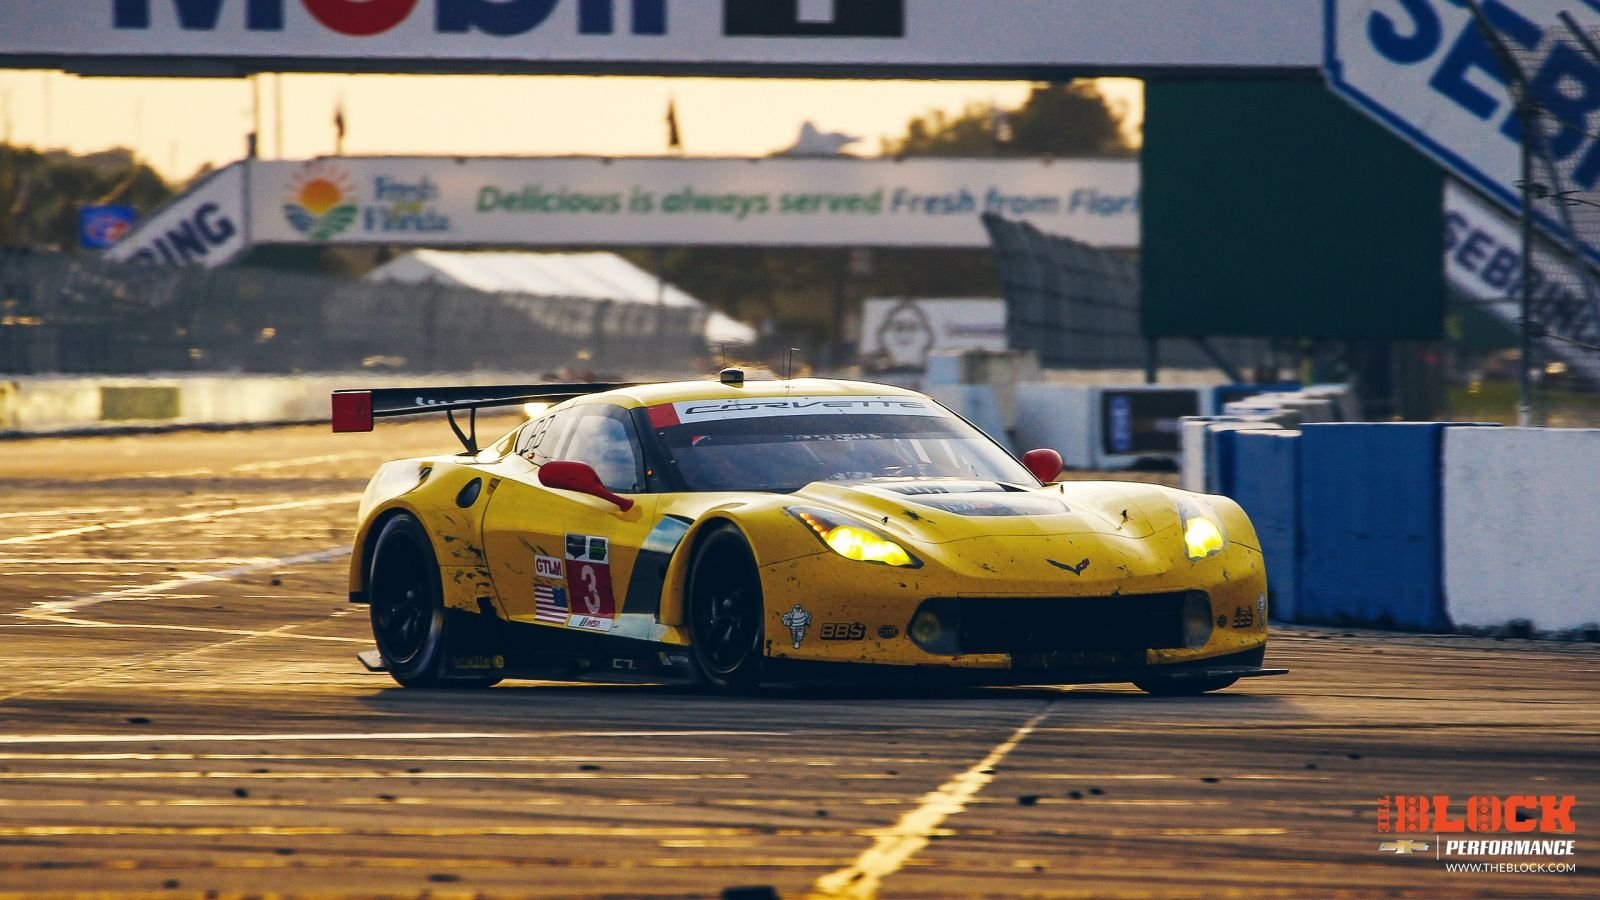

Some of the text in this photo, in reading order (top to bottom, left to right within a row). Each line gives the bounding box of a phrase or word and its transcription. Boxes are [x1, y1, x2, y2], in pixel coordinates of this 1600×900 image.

[1367, 0, 1600, 190] SEB
[476, 186, 621, 214] Delicious
[629, 186, 654, 214] is
[661, 185, 770, 221] always
[780, 187, 885, 214] served
[891, 187, 976, 214] Fresh
[685, 400, 927, 415] CORVETTE
[535, 558, 562, 576] GTLM
[581, 564, 601, 614] 3
[820, 622, 866, 640] BBS
